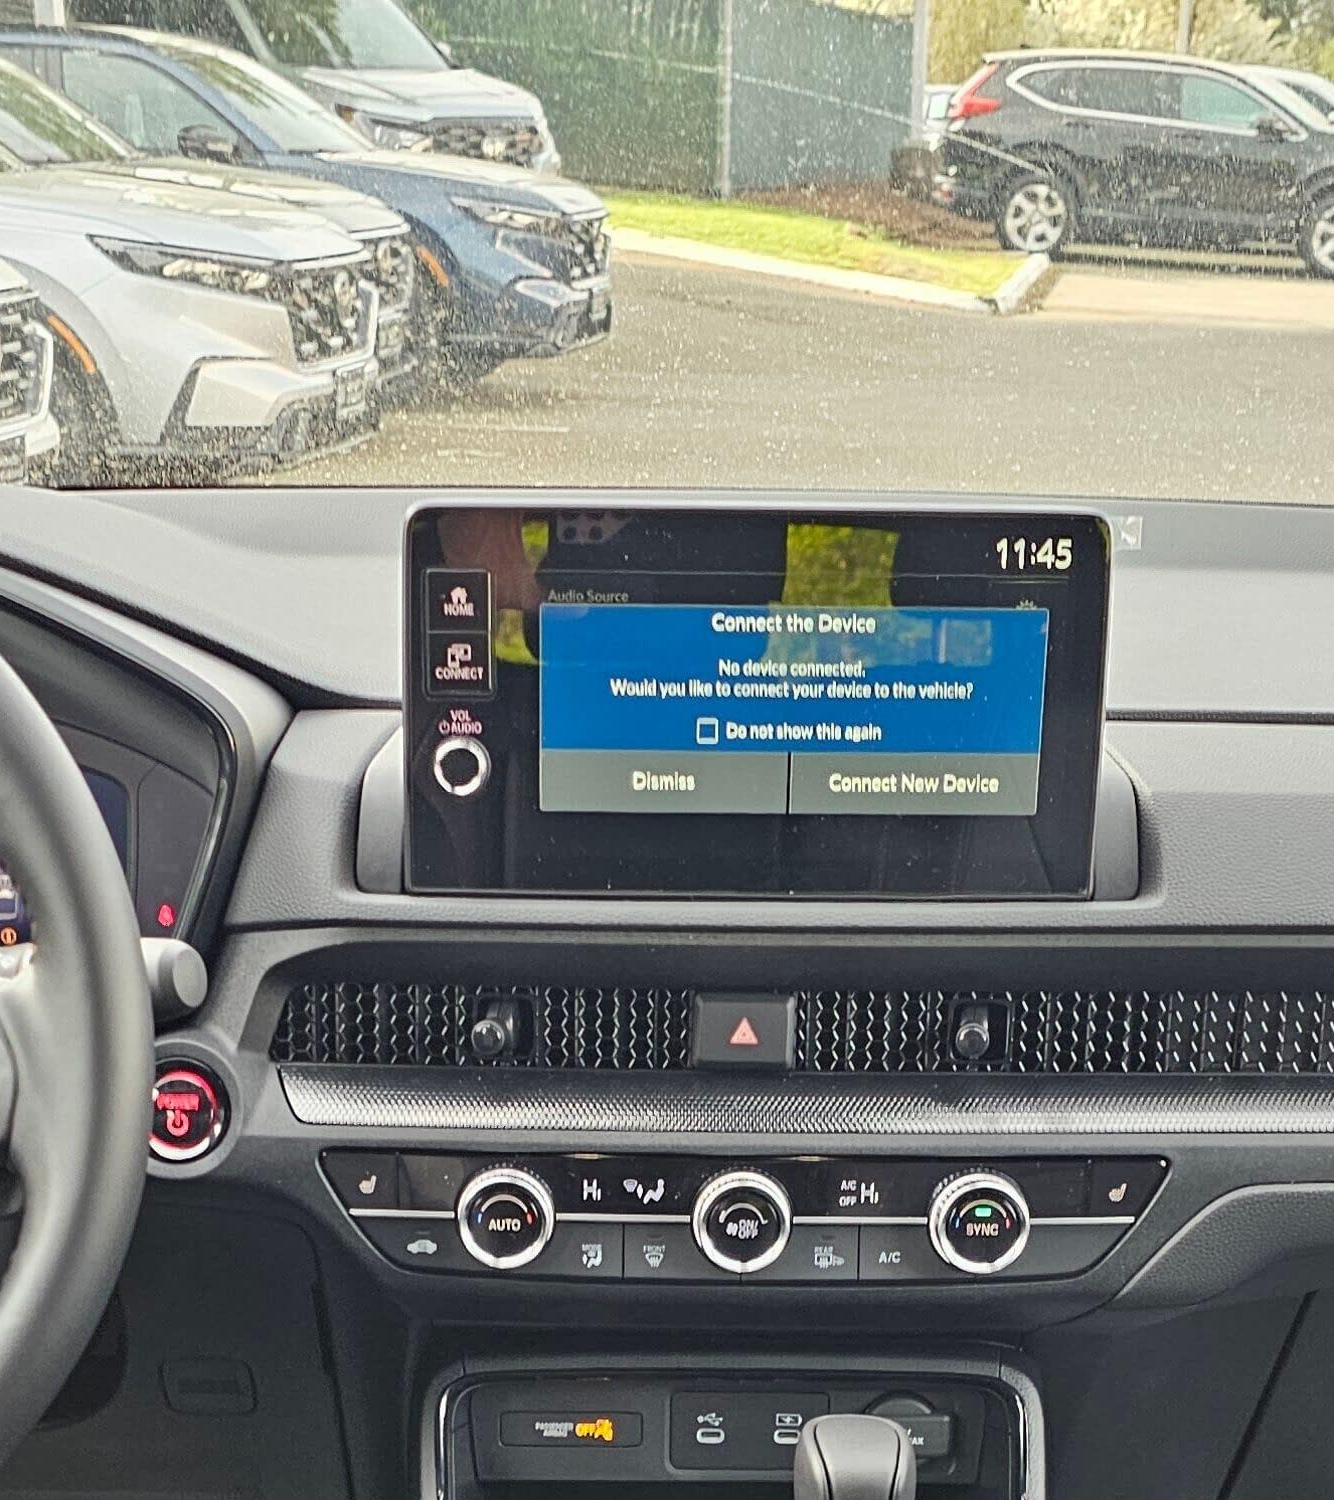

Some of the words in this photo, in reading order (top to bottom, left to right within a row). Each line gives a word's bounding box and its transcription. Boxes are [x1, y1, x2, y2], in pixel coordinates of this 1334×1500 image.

[995, 537, 1074, 571] 11:45
[547, 588, 580, 604] Audio
[584, 588, 629, 604] Source
[443, 602, 475, 617] HOME
[711, 611, 782, 633] Connect
[786, 613, 814, 634] the
[818, 613, 877, 634] Device
[434, 666, 484, 681] CONNECT
[719, 659, 740, 677] No
[743, 659, 788, 677] device
[790, 660, 866, 679] connected.
[610, 678, 657, 698] Would
[660, 681, 686, 700] you
[689, 679, 714, 698] like
[716, 681, 731, 699] to
[733, 681, 789, 699] connect
[792, 684, 825, 701] your
[827, 681, 872, 699] device
[874, 682, 890, 699] to
[893, 681, 916, 699] the
[918, 682, 974, 700] vehicle?
[449, 709, 472, 723] VOL
[451, 721, 483, 735] AUDIO
[725, 721, 747, 741] Do
[750, 723, 774, 741] not
[776, 722, 813, 742] show
[816, 722, 842, 742] this
[845, 723, 883, 744] again
[631, 770, 696, 792] Dismiss
[828, 773, 897, 796] Connect
[901, 774, 940, 795] New
[945, 774, 1000, 796] Device
[840, 1179, 858, 1192] A/C
[838, 1195, 858, 1207] OFF
[488, 1218, 521, 1233] AUTO
[966, 1222, 999, 1237] SYNC
[878, 1251, 902, 1265] A/C
[575, 1423, 598, 1438] OFF
